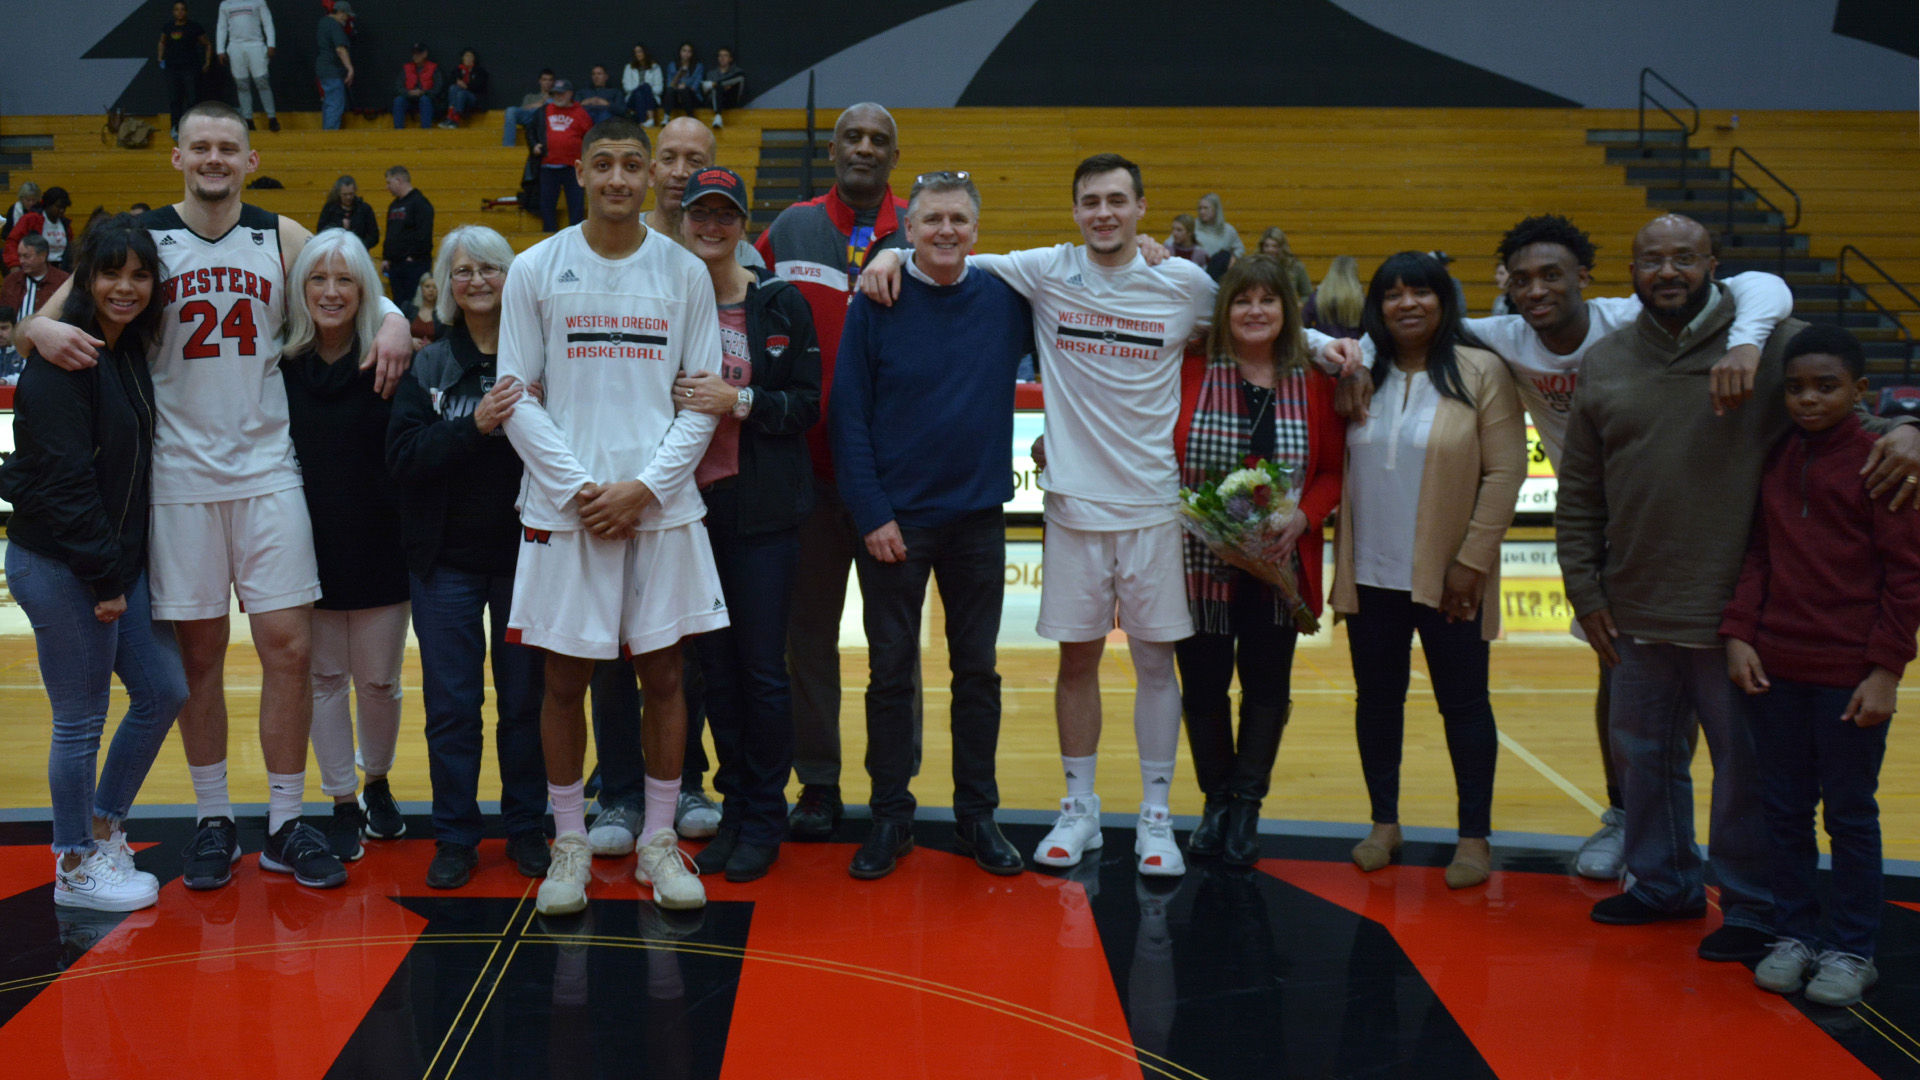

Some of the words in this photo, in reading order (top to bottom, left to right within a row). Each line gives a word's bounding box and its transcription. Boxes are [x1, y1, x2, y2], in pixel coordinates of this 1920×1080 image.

[160, 267, 272, 308] WESTERN
[179, 298, 258, 360] 24
[565, 315, 619, 329] WESTERN
[621, 316, 669, 331] OREGON
[1058, 311, 1113, 328] WESTERN
[1116, 317, 1165, 333] OREGON
[567, 345, 665, 361] BASKETBALL
[1055, 338, 1160, 361] BASKETBALL
[1533, 489, 1551, 504] of
